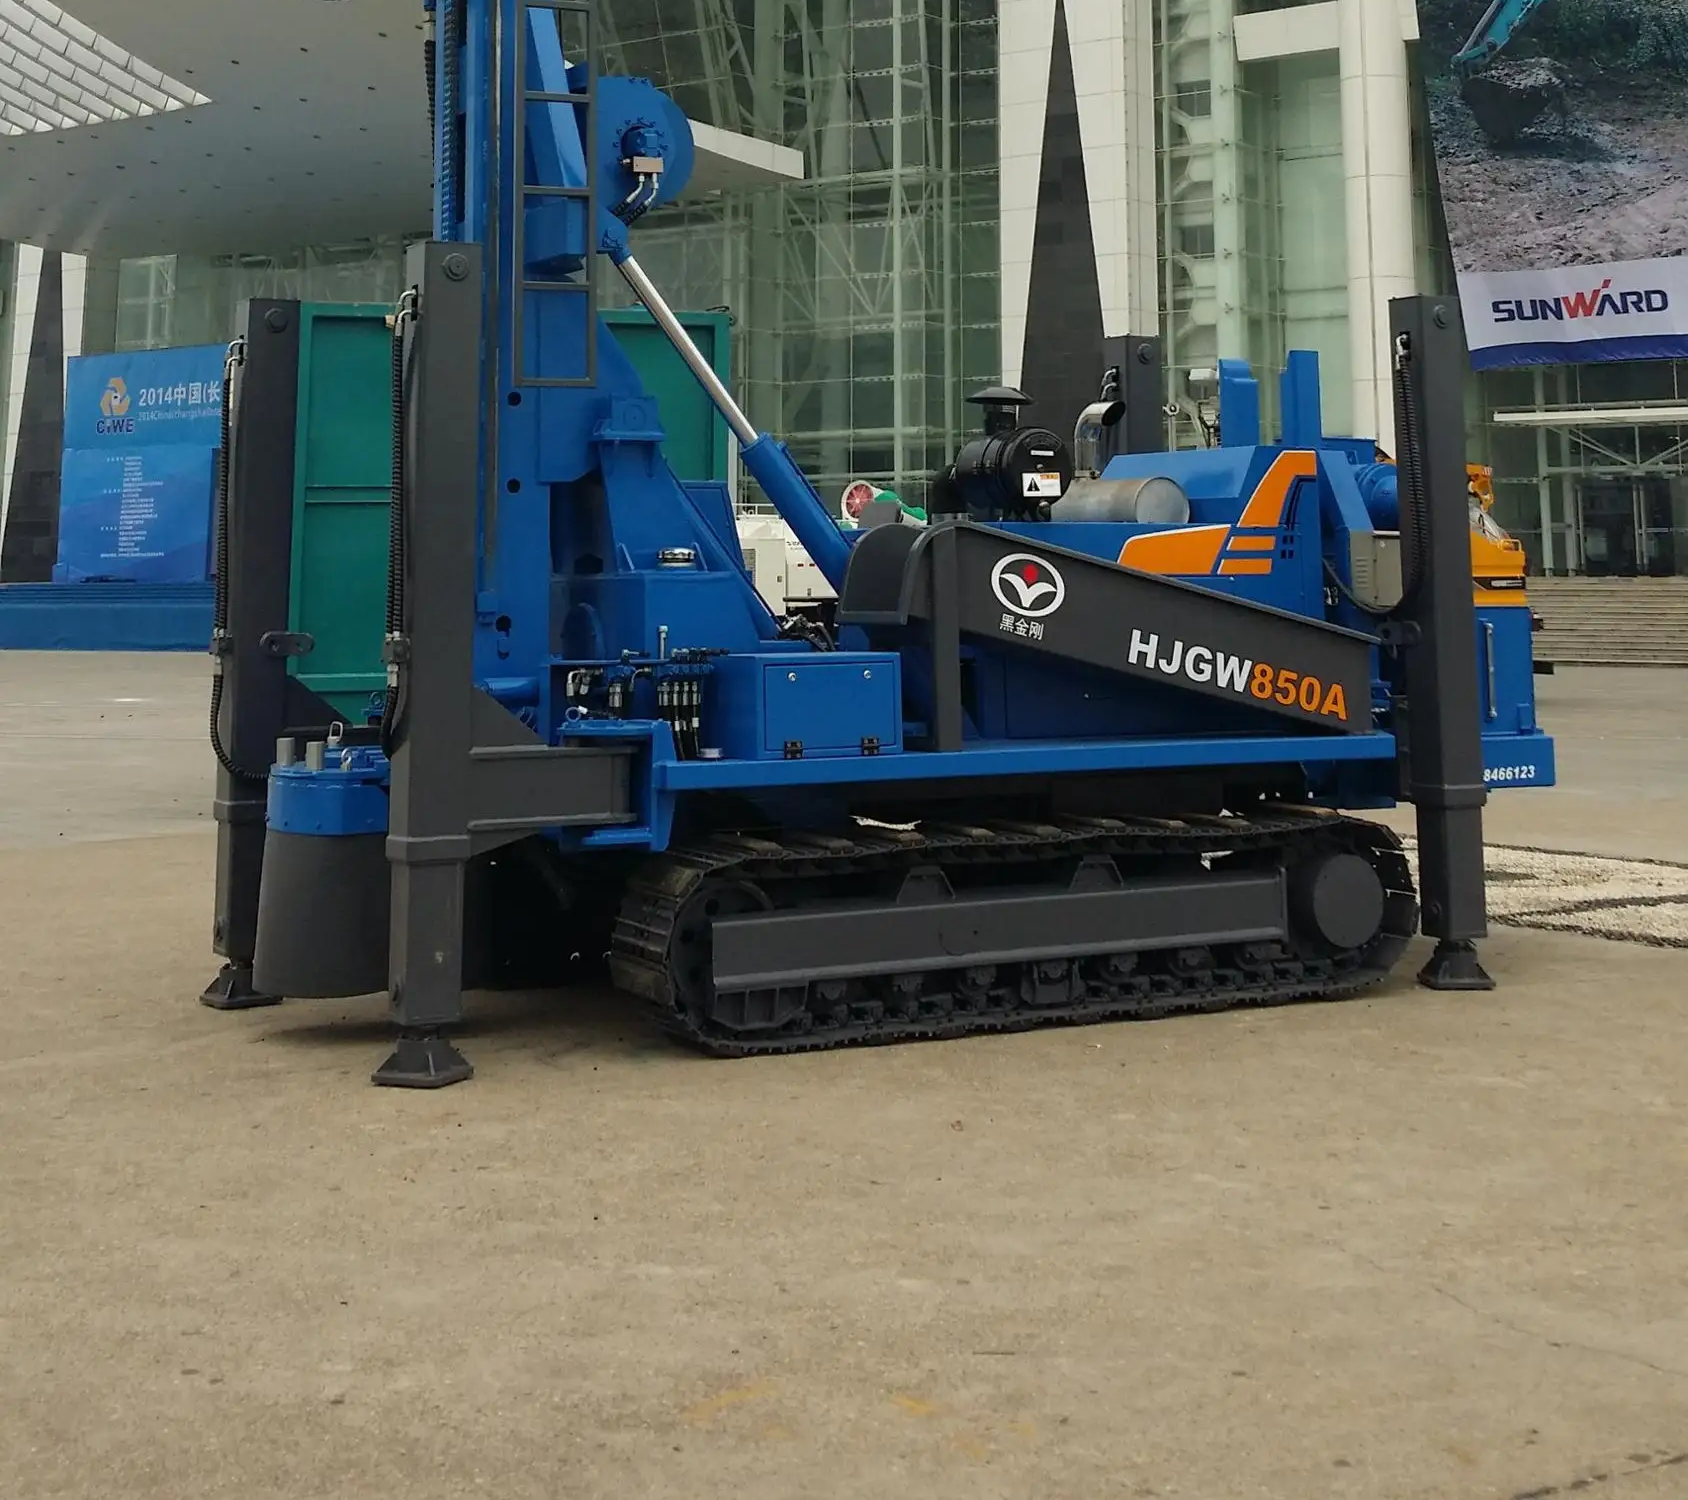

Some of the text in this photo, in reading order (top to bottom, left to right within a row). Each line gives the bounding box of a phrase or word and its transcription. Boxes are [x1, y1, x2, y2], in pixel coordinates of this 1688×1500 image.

[1492, 279, 1668, 322] SUNWARD
[999, 613, 1044, 641] 黑金刚
[1127, 628, 1348, 721] HJGW850A
[1483, 765, 1535, 782] 8466123
